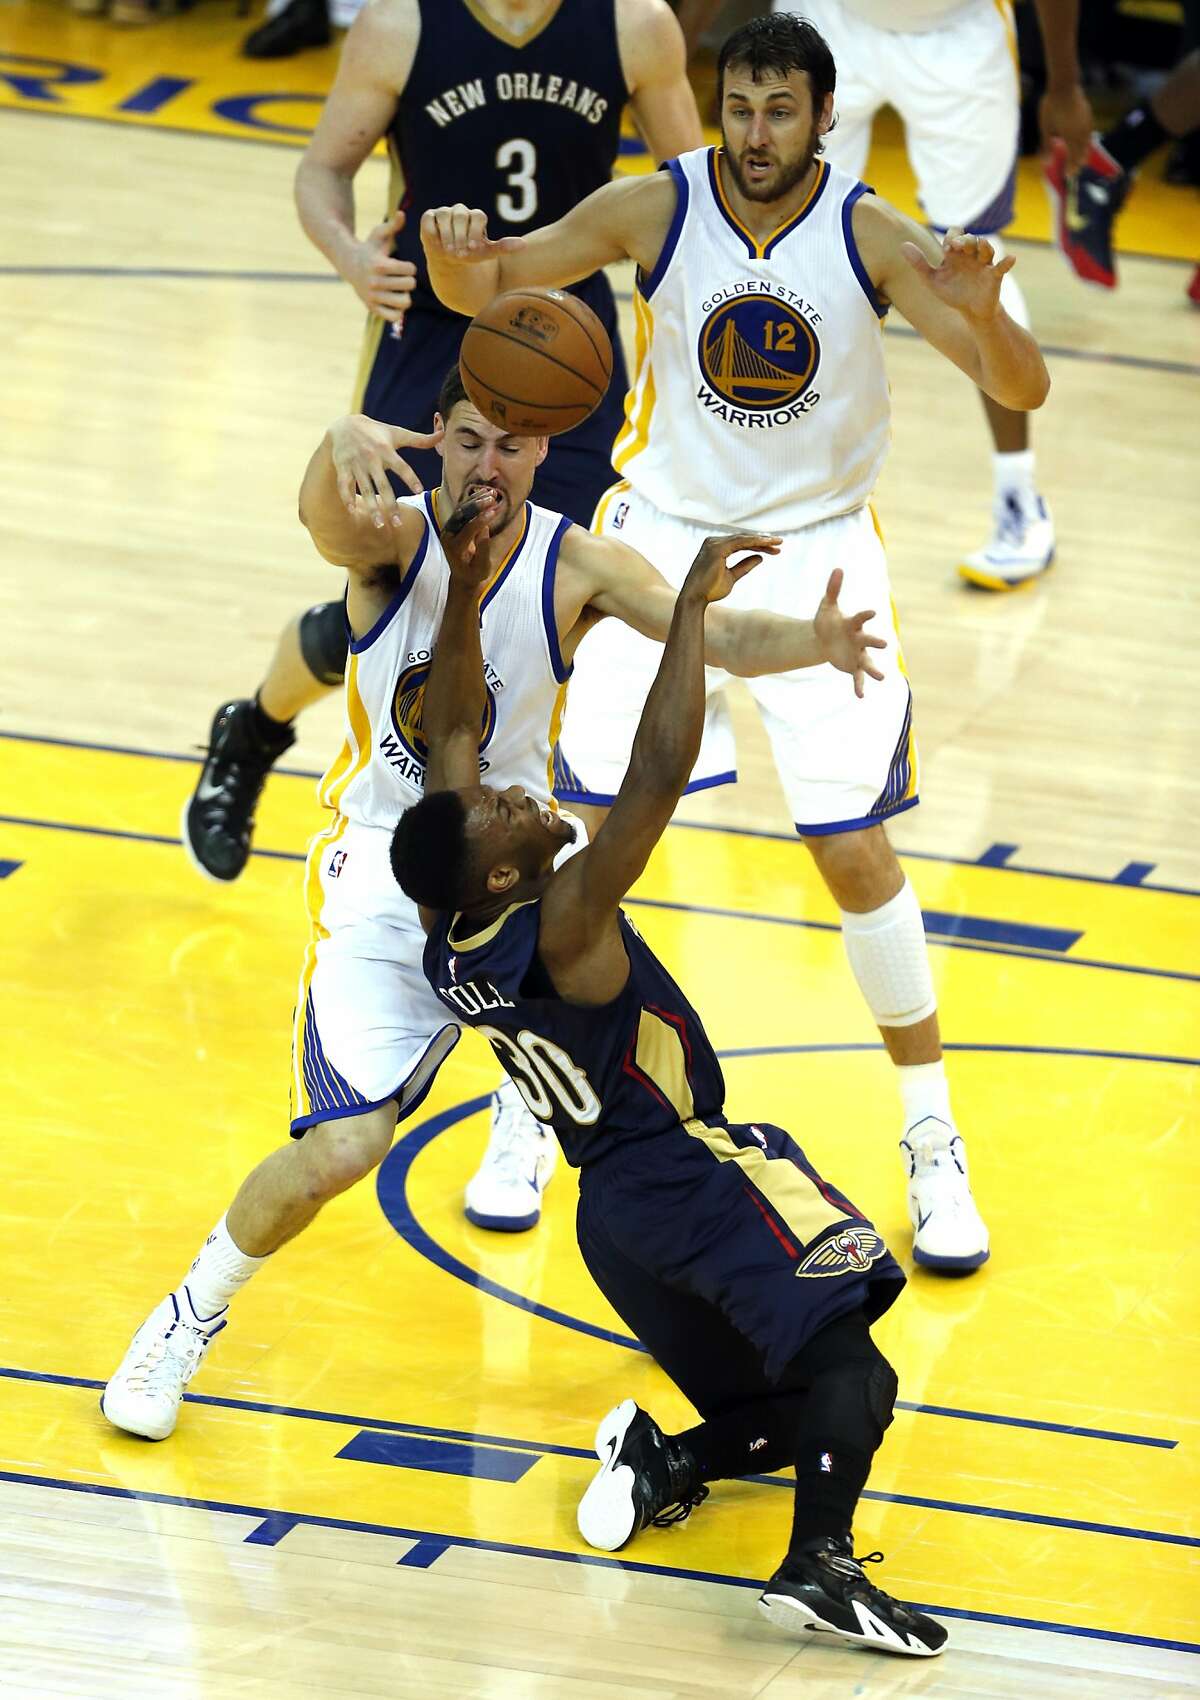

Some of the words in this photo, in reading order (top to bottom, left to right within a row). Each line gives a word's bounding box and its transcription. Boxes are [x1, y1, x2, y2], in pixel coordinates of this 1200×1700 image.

[424, 78, 487, 128] NEW
[495, 72, 609, 125] ORLEANS
[496, 137, 539, 223] 3
[702, 281, 772, 313] GOLDEN
[775, 286, 823, 326] STATE
[763, 320, 796, 352] 12
[697, 385, 821, 429] WARRIORS
[475, 1023, 603, 1127] 30
